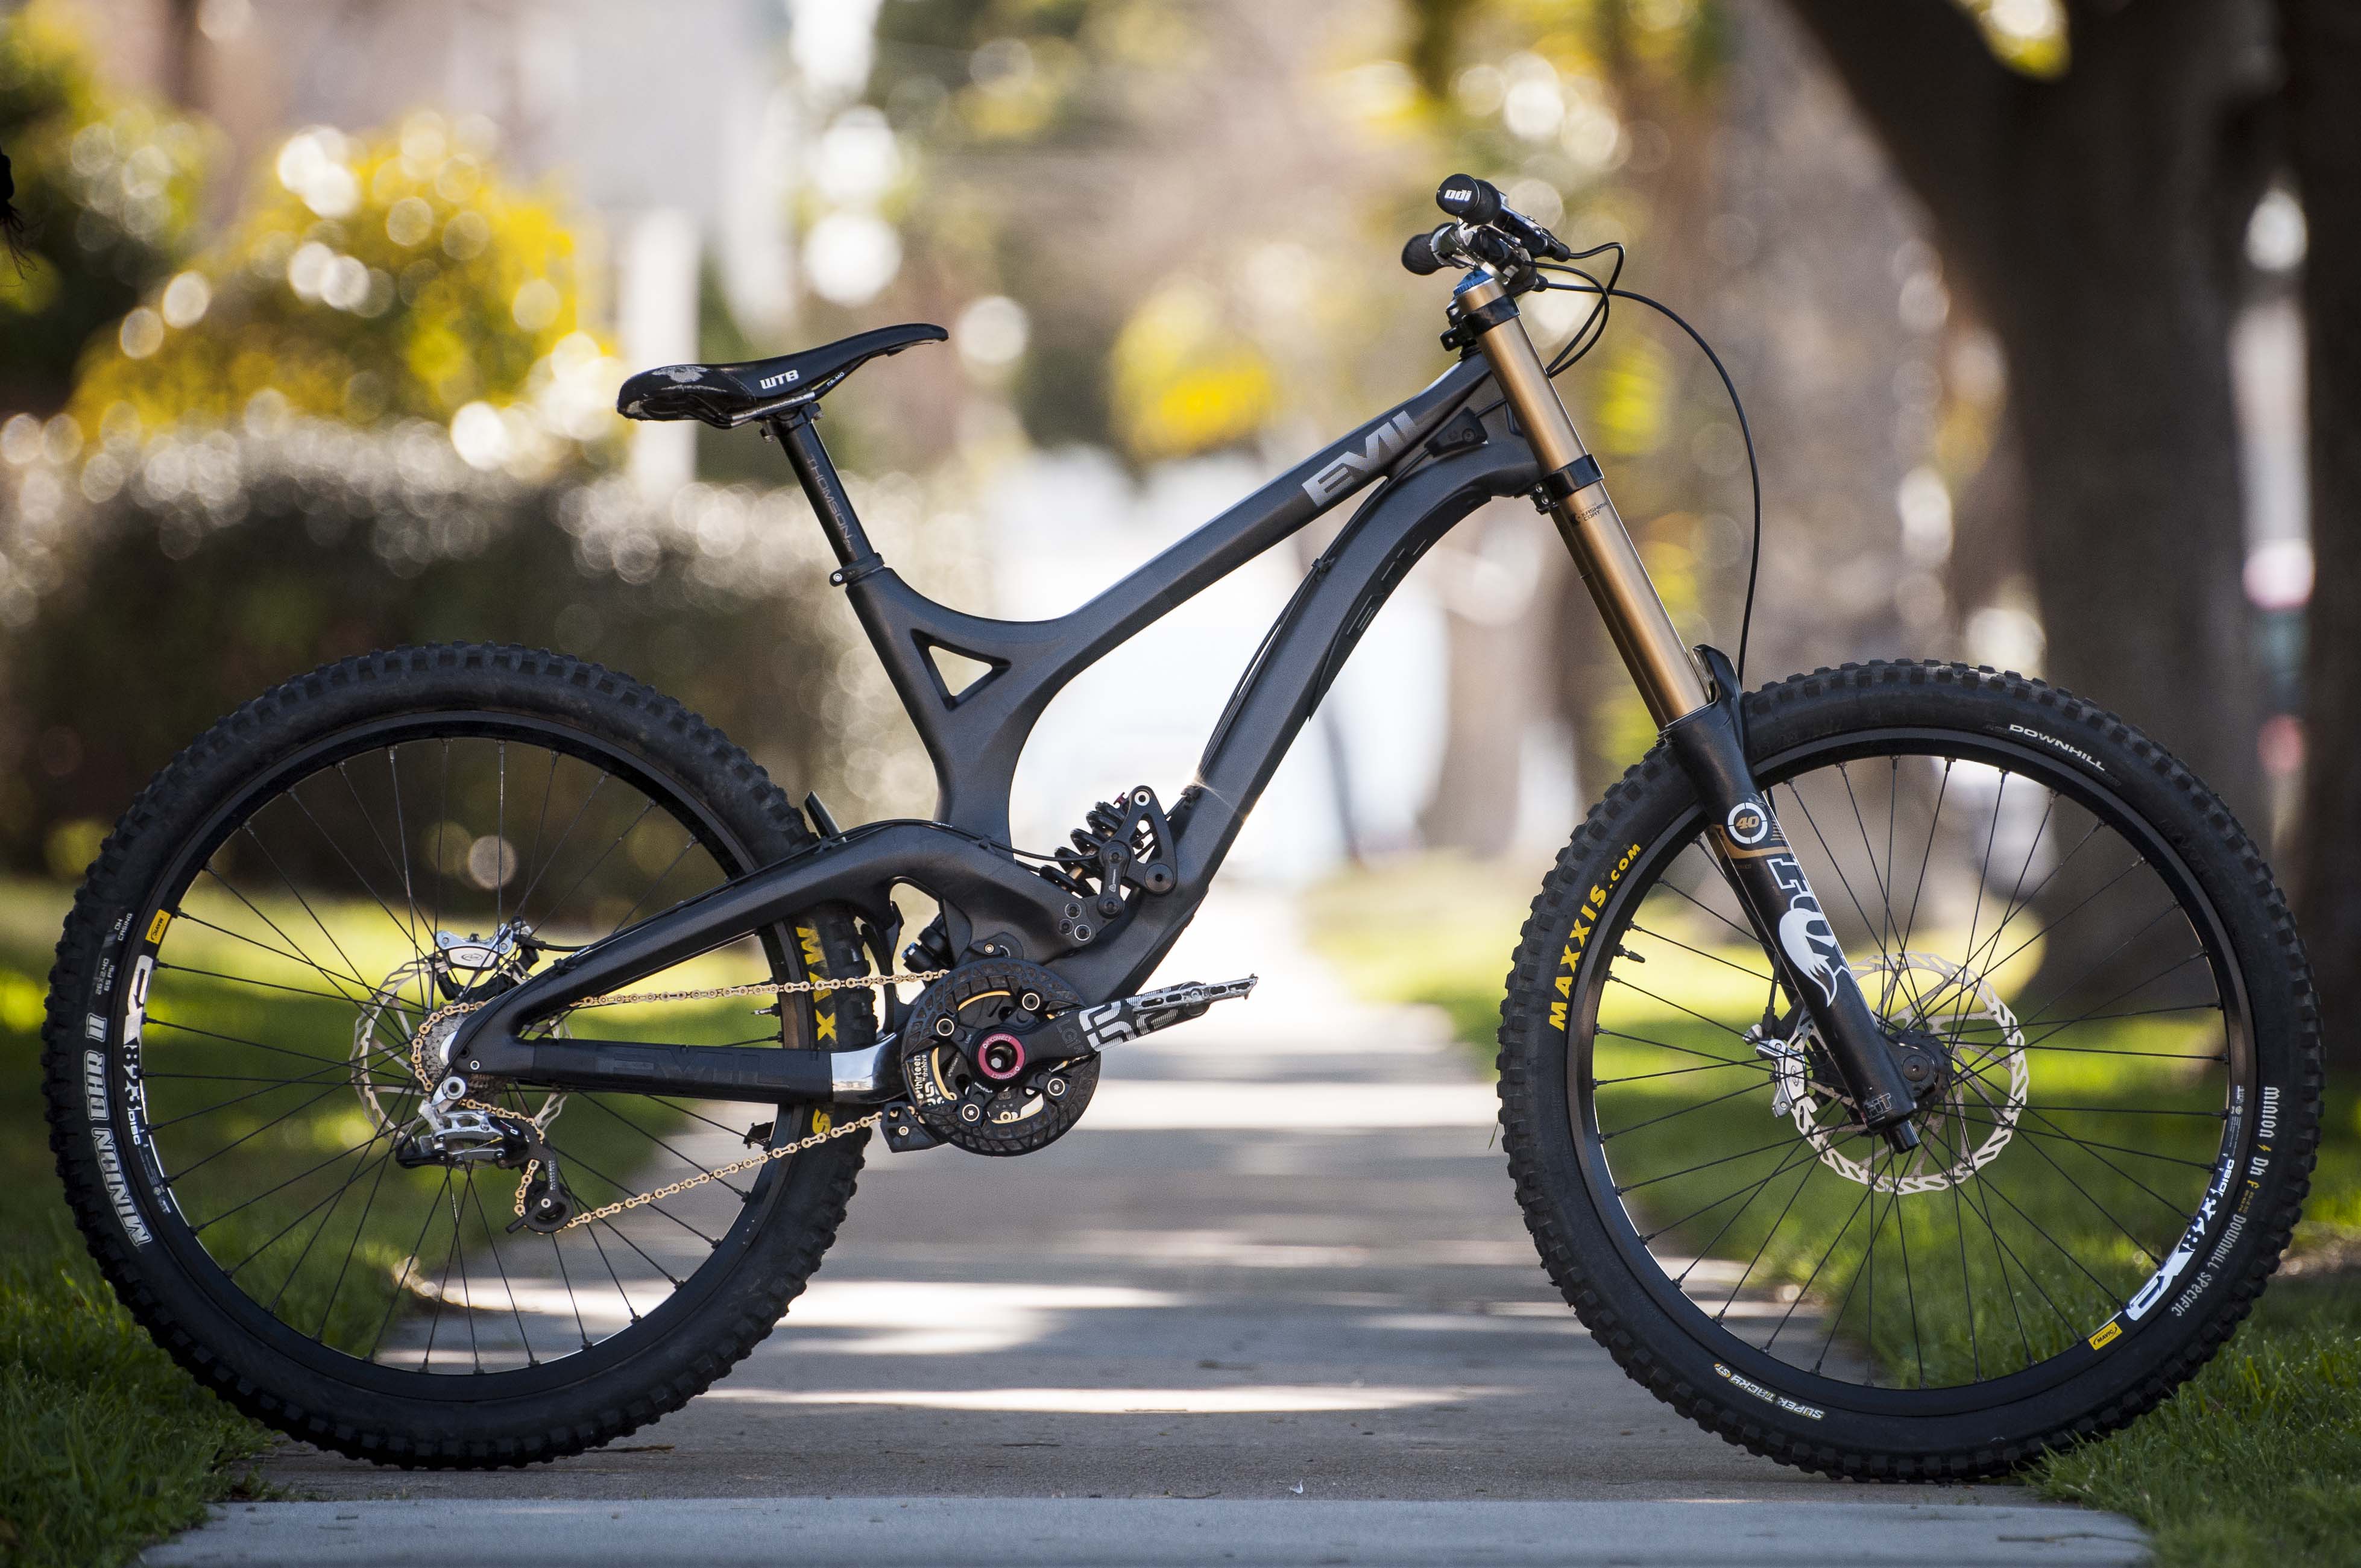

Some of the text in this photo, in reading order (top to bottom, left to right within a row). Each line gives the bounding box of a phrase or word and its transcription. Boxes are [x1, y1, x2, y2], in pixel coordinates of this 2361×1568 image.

[760, 370, 799, 389] WTB
[1301, 411, 1417, 508] EVIL
[807, 457, 854, 539] THOMSON
[2009, 724, 2105, 771] DOWNHILL
[1736, 815, 1759, 830] 40
[1549, 843, 1641, 1031] MAXXIS.COM
[84, 1050, 109, 1121] DHR
[126, 1111, 140, 1146] DISC
[92, 1128, 152, 1246] MINION
[1729, 1374, 1776, 1403] TACKY
[1776, 1396, 1825, 1420] SUPER
